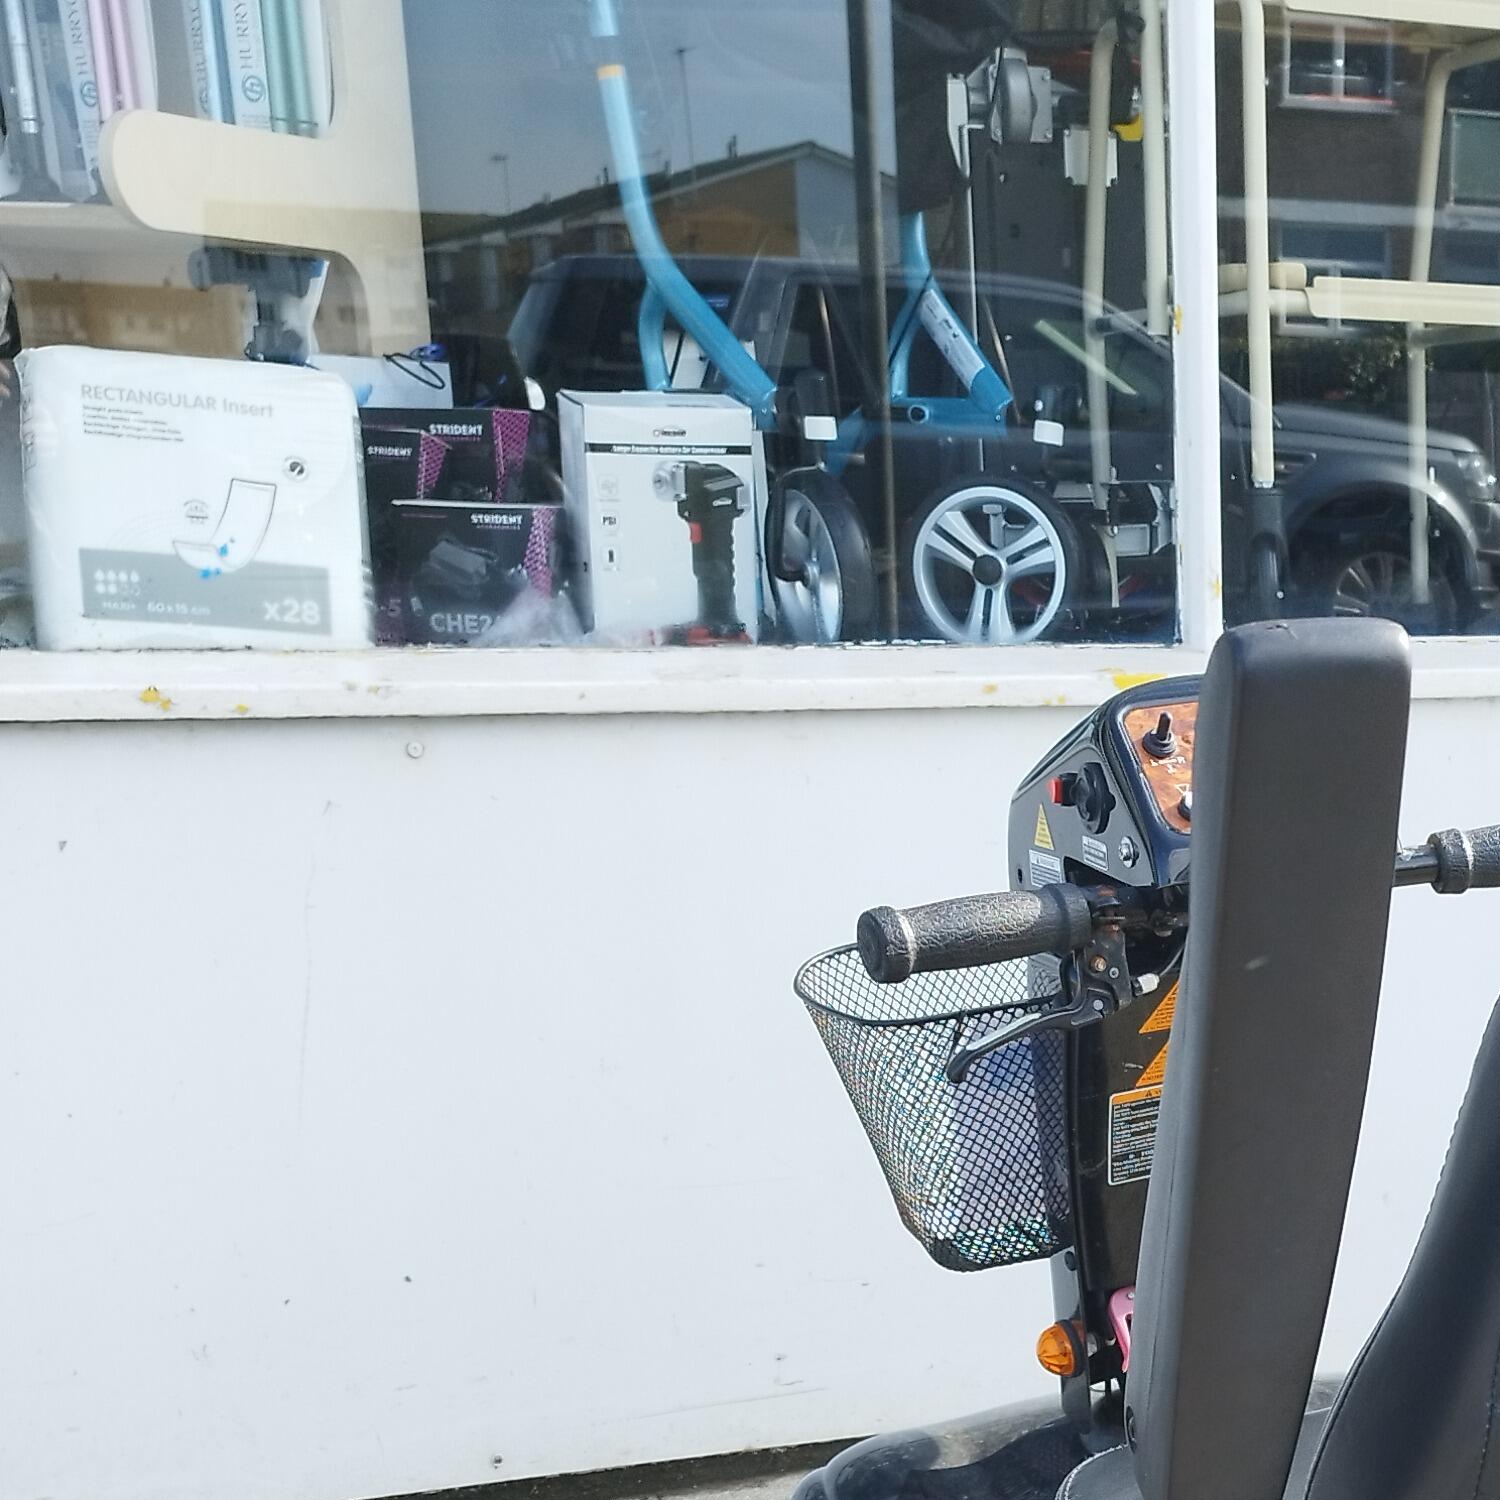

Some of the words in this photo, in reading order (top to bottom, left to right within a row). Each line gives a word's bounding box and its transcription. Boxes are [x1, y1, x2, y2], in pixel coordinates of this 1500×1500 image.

[81, 384, 216, 411] RECTANGULAR
[223, 397, 275, 418] Insert
[429, 423, 483, 436] STRIDENT
[470, 512, 524, 526] STRIDENT
[263, 597, 321, 625] x28
